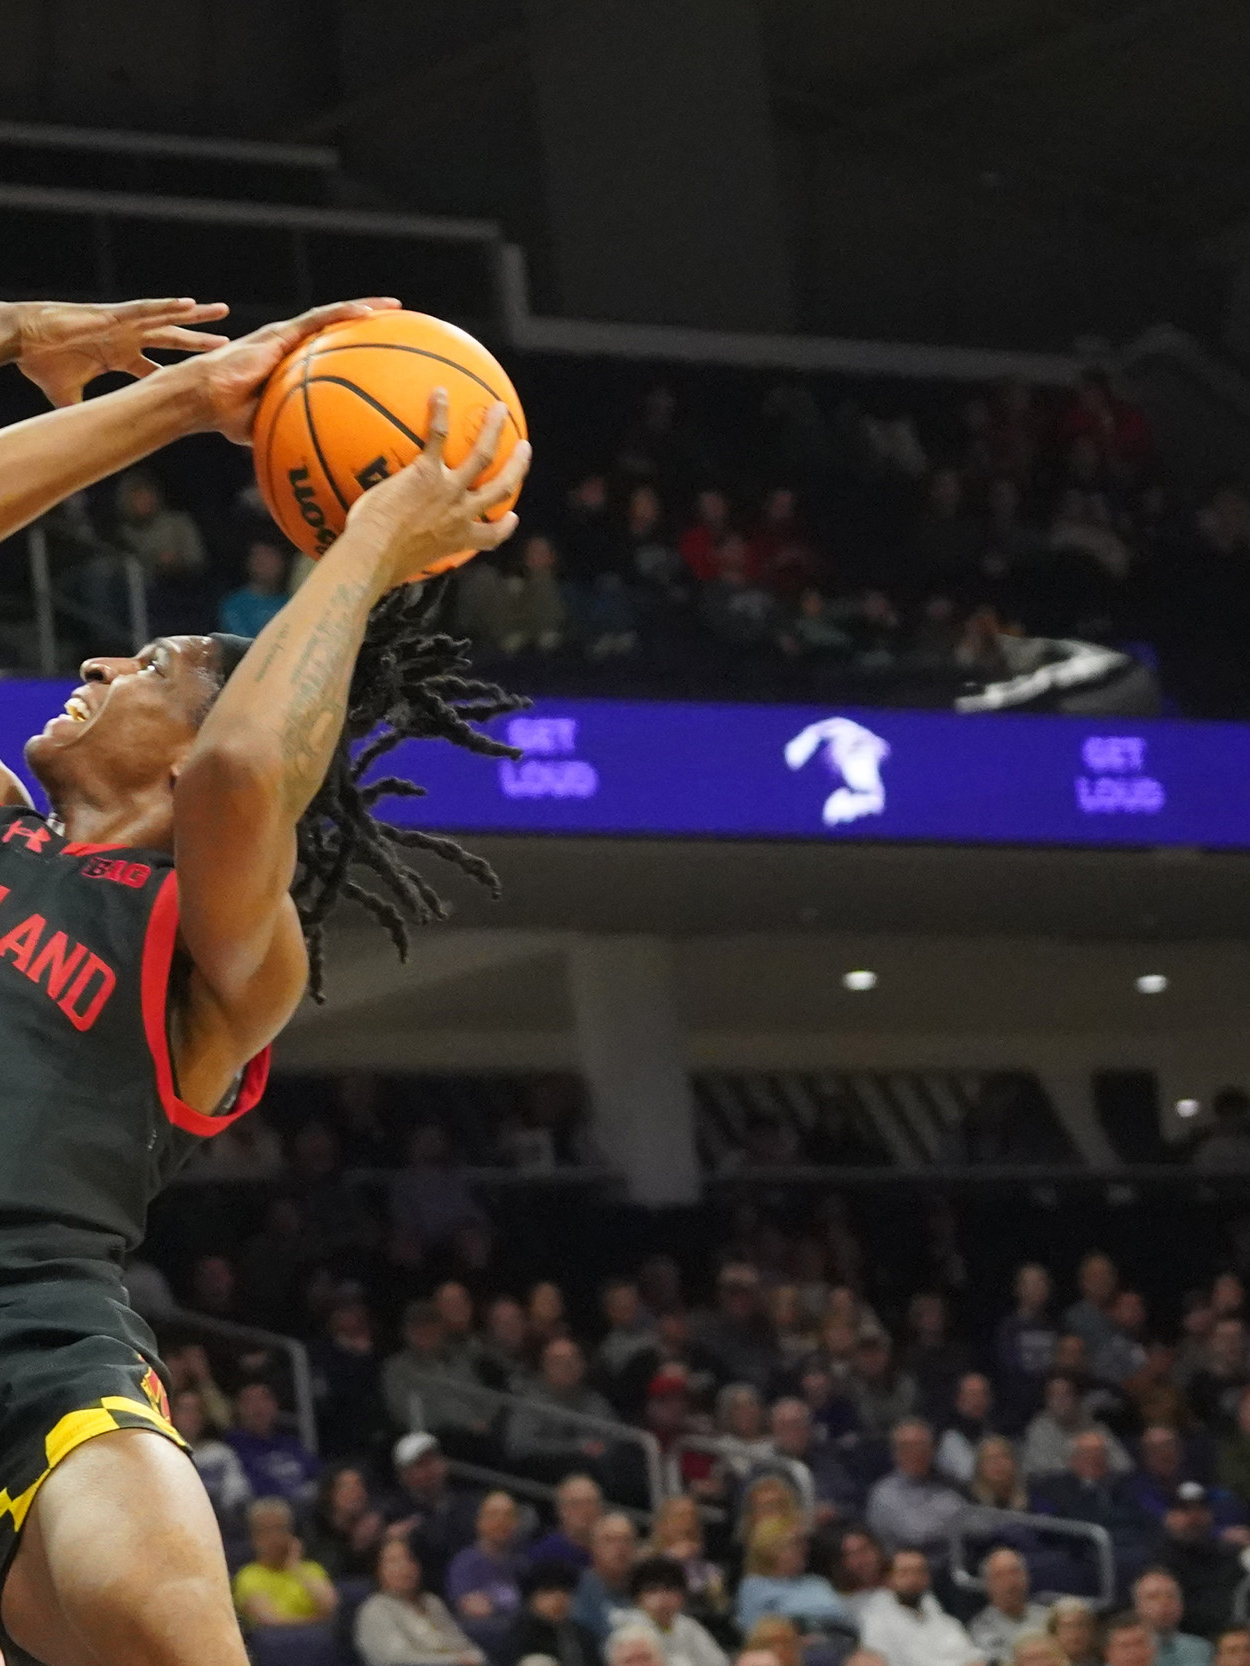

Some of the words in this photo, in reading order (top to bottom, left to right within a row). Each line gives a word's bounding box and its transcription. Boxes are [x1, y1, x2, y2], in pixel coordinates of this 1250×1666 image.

[507, 717, 578, 753] GET
[1081, 735, 1146, 770] GET
[498, 759, 599, 799] LOUD
[1074, 776, 1167, 814] LOUD
